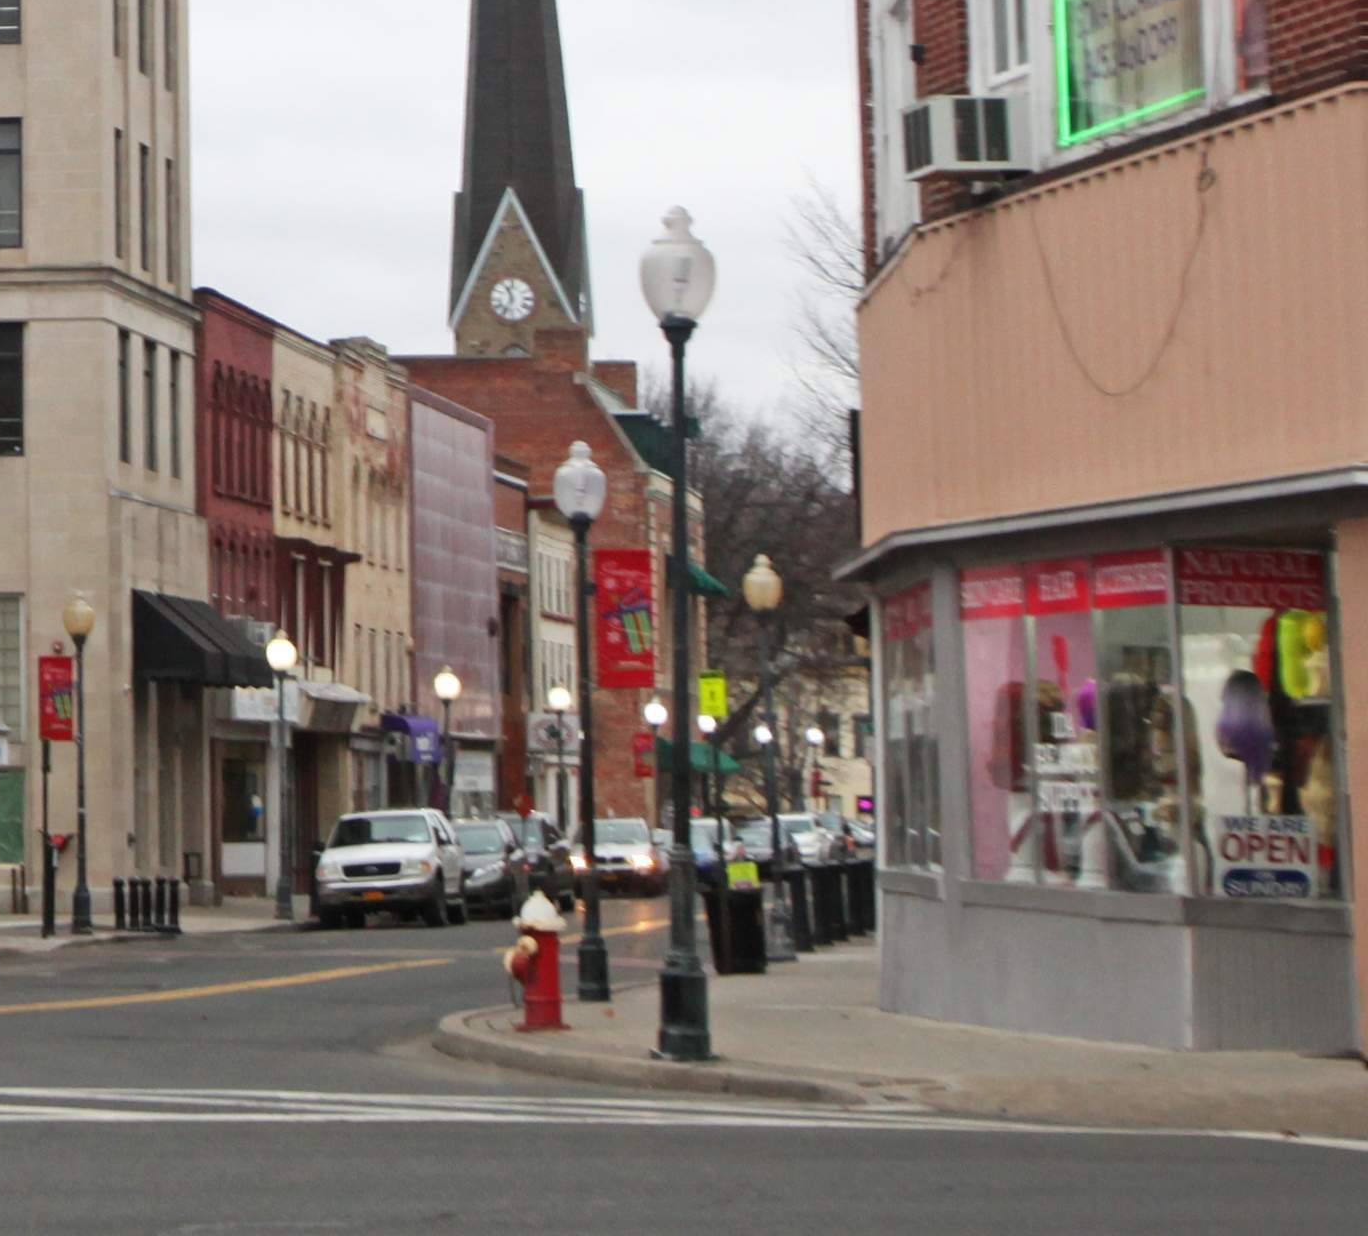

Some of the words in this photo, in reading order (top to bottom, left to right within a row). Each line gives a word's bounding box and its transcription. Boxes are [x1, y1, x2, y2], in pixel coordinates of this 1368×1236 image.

[1182, 550, 1318, 578] NATURAL
[1182, 579, 1326, 607] PRODUCTS
[1222, 816, 1259, 831] WE
[1268, 817, 1310, 833] ARE
[1221, 833, 1310, 864] OPEN
[1225, 879, 1308, 897] SUNDAY
